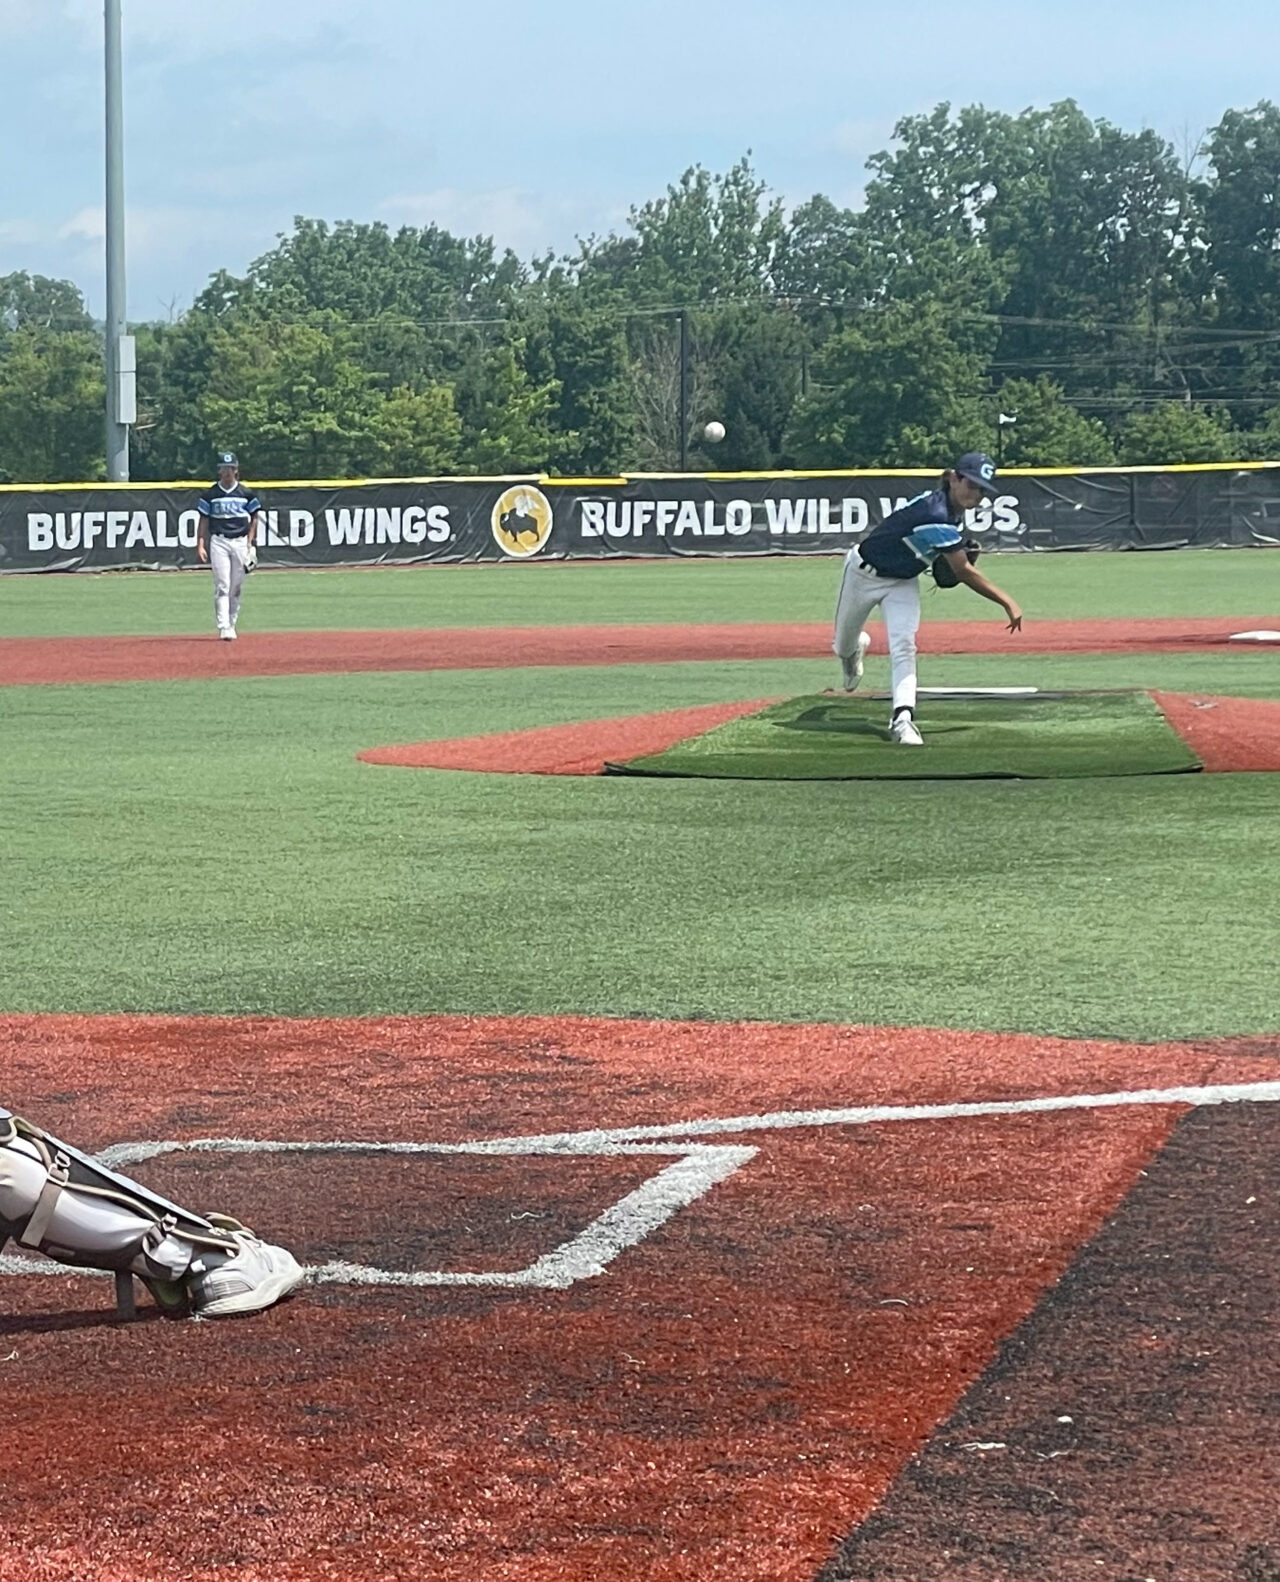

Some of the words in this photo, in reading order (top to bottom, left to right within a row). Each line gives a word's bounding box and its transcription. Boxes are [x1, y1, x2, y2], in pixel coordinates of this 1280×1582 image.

[980, 463, 995, 481] G
[28, 510, 200, 550] BUFFALO
[255, 509, 315, 547] ILD
[581, 499, 752, 537] BUFFALO
[765, 498, 869, 534] WILD
